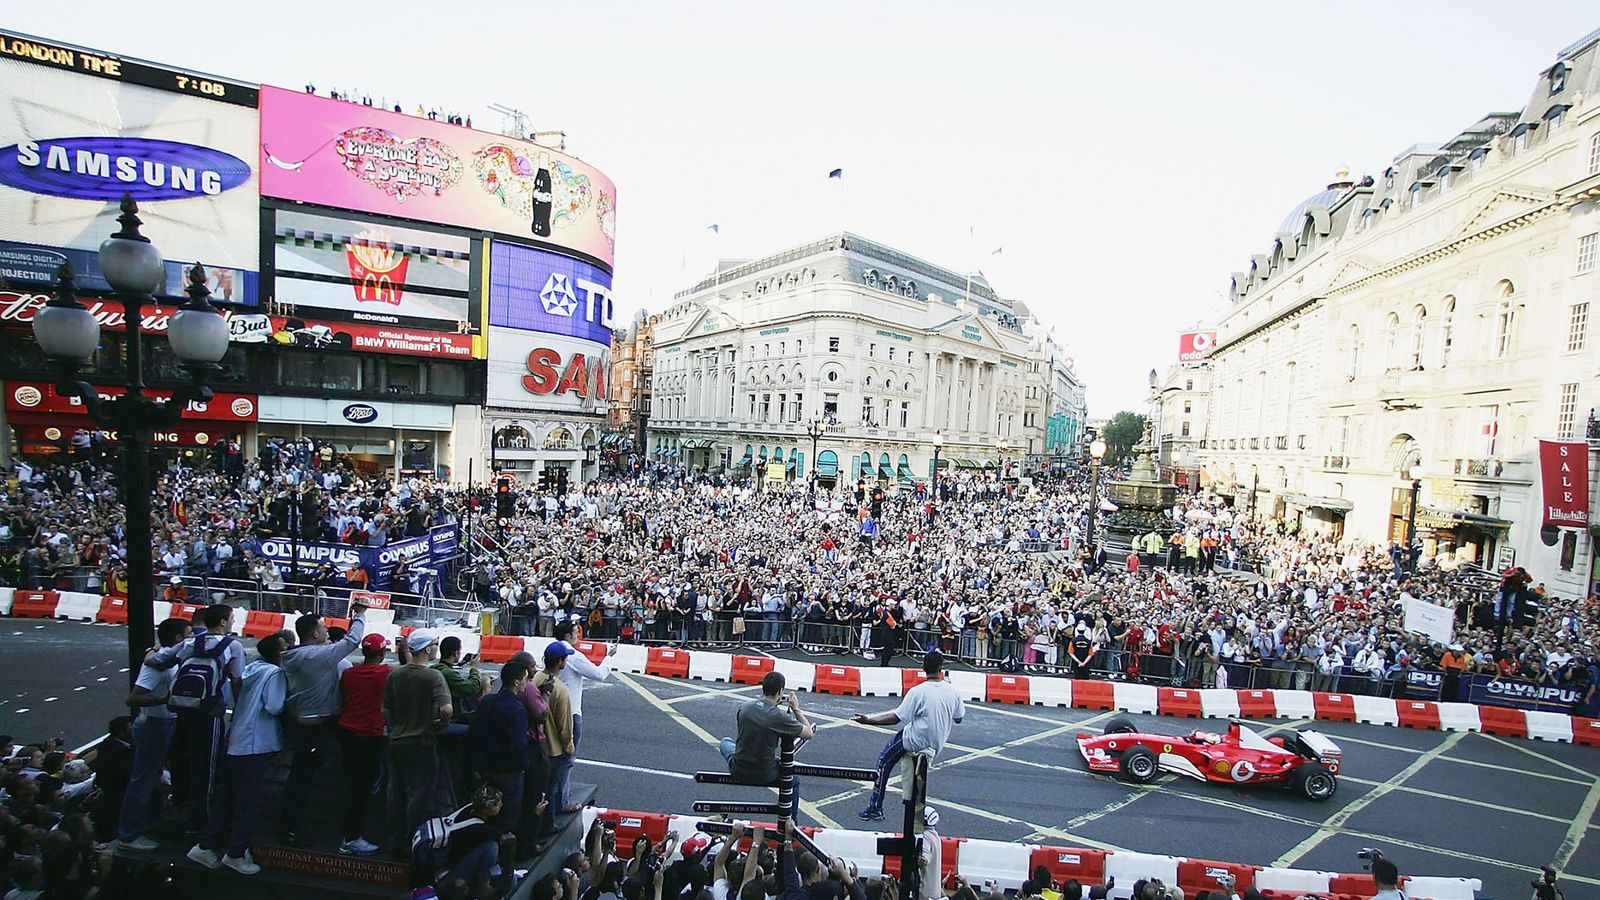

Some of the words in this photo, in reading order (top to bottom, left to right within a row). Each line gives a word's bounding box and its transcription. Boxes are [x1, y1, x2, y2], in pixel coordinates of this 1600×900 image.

[0, 37, 74, 66] LONDON
[80, 53, 122, 76] TIME
[175, 75, 225, 97] 7:08
[17, 140, 222, 195] SAMSUNG
[0, 251, 32, 262] AMSUNG
[0, 268, 51, 281] ROJECTION
[229, 318, 269, 336] Bud
[353, 312, 399, 324] McDonald's
[355, 336, 384, 348] BMW
[386, 339, 441, 352] WilliamsF1
[443, 344, 470, 354] Team
[378, 331, 403, 340] Official
[404, 333, 432, 343] Sponsor
[441, 336, 452, 344] the
[346, 406, 374, 420] Boots
[1559, 446, 1573, 503] SALE
[434, 531, 455, 542] OLYMPUS
[262, 541, 360, 563] OLYMPUS
[379, 541, 430, 564] OLYMPUS
[1486, 681, 1582, 703] OLYMPUS
